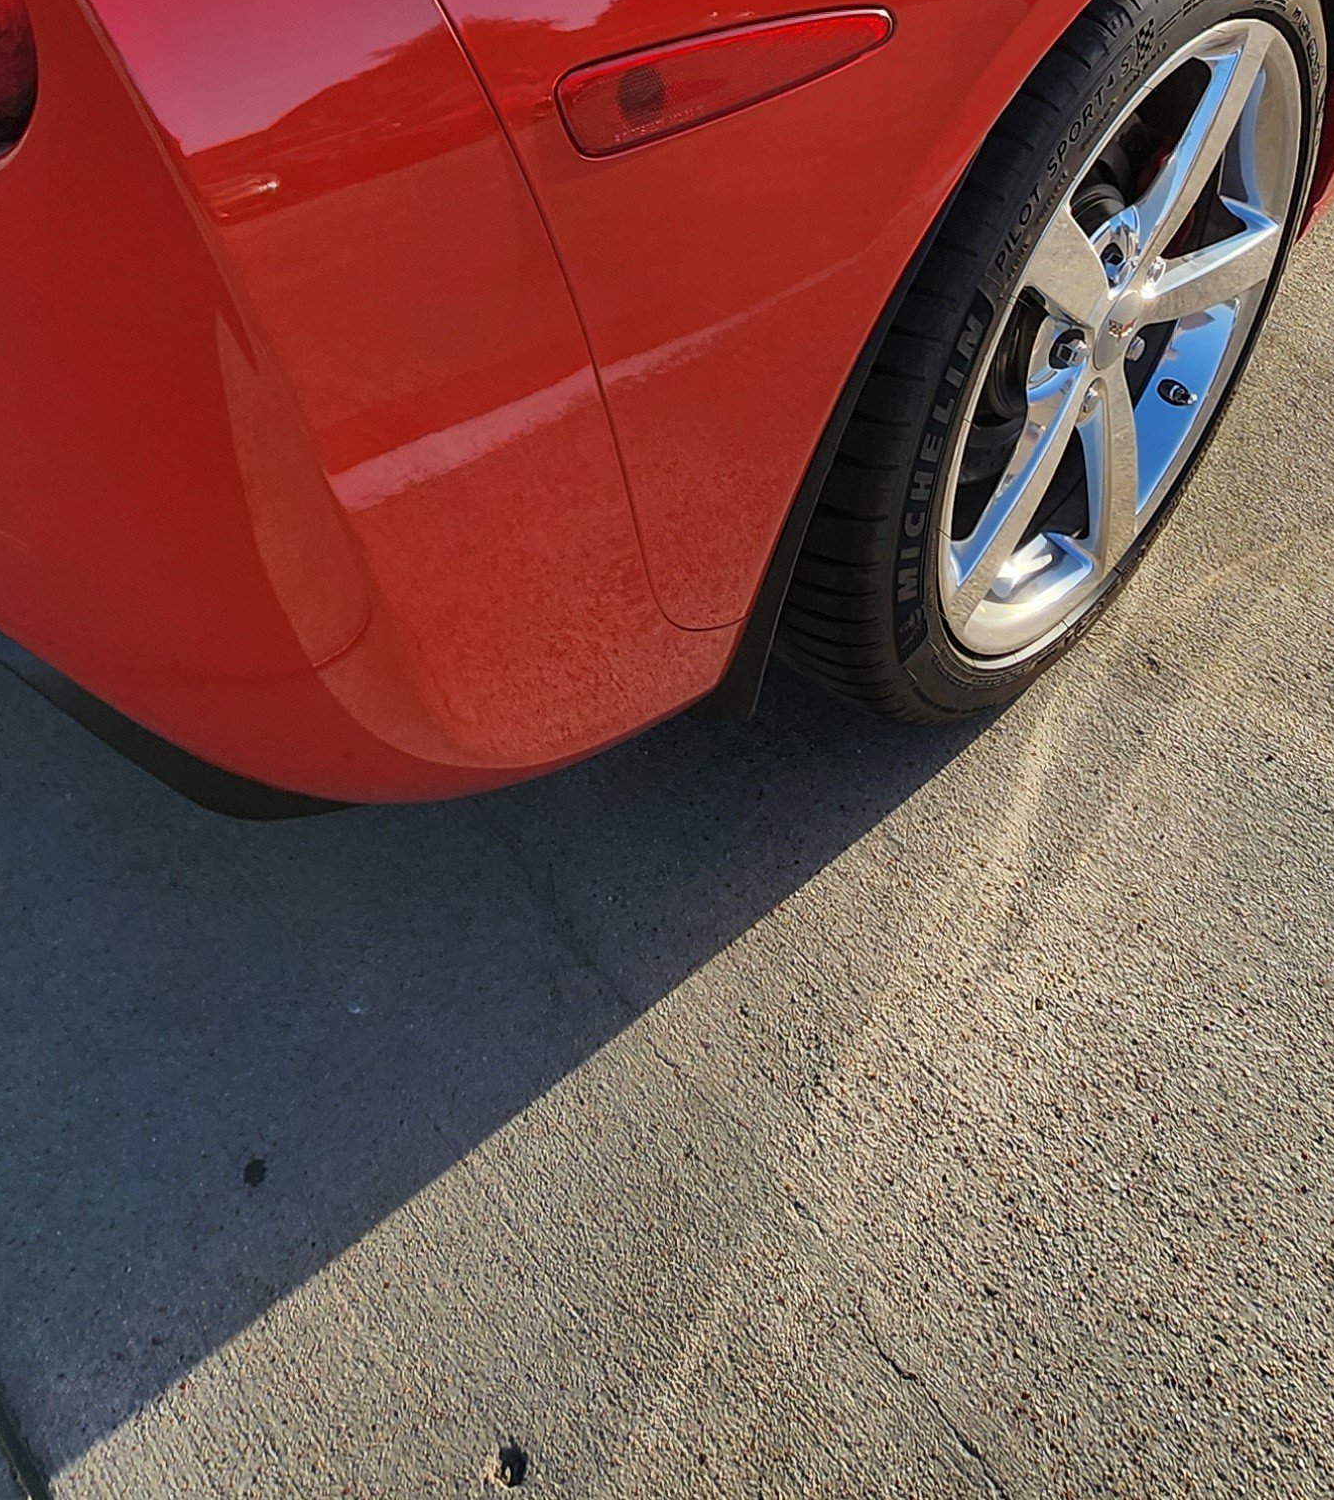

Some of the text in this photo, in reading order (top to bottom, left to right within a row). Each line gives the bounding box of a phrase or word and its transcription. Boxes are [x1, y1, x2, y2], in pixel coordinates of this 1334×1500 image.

[994, 182, 1041, 273] PILOT
[1047, 87, 1104, 178] SPORT
[1120, 55, 1131, 76] S
[898, 313, 983, 602] MICHELIN
